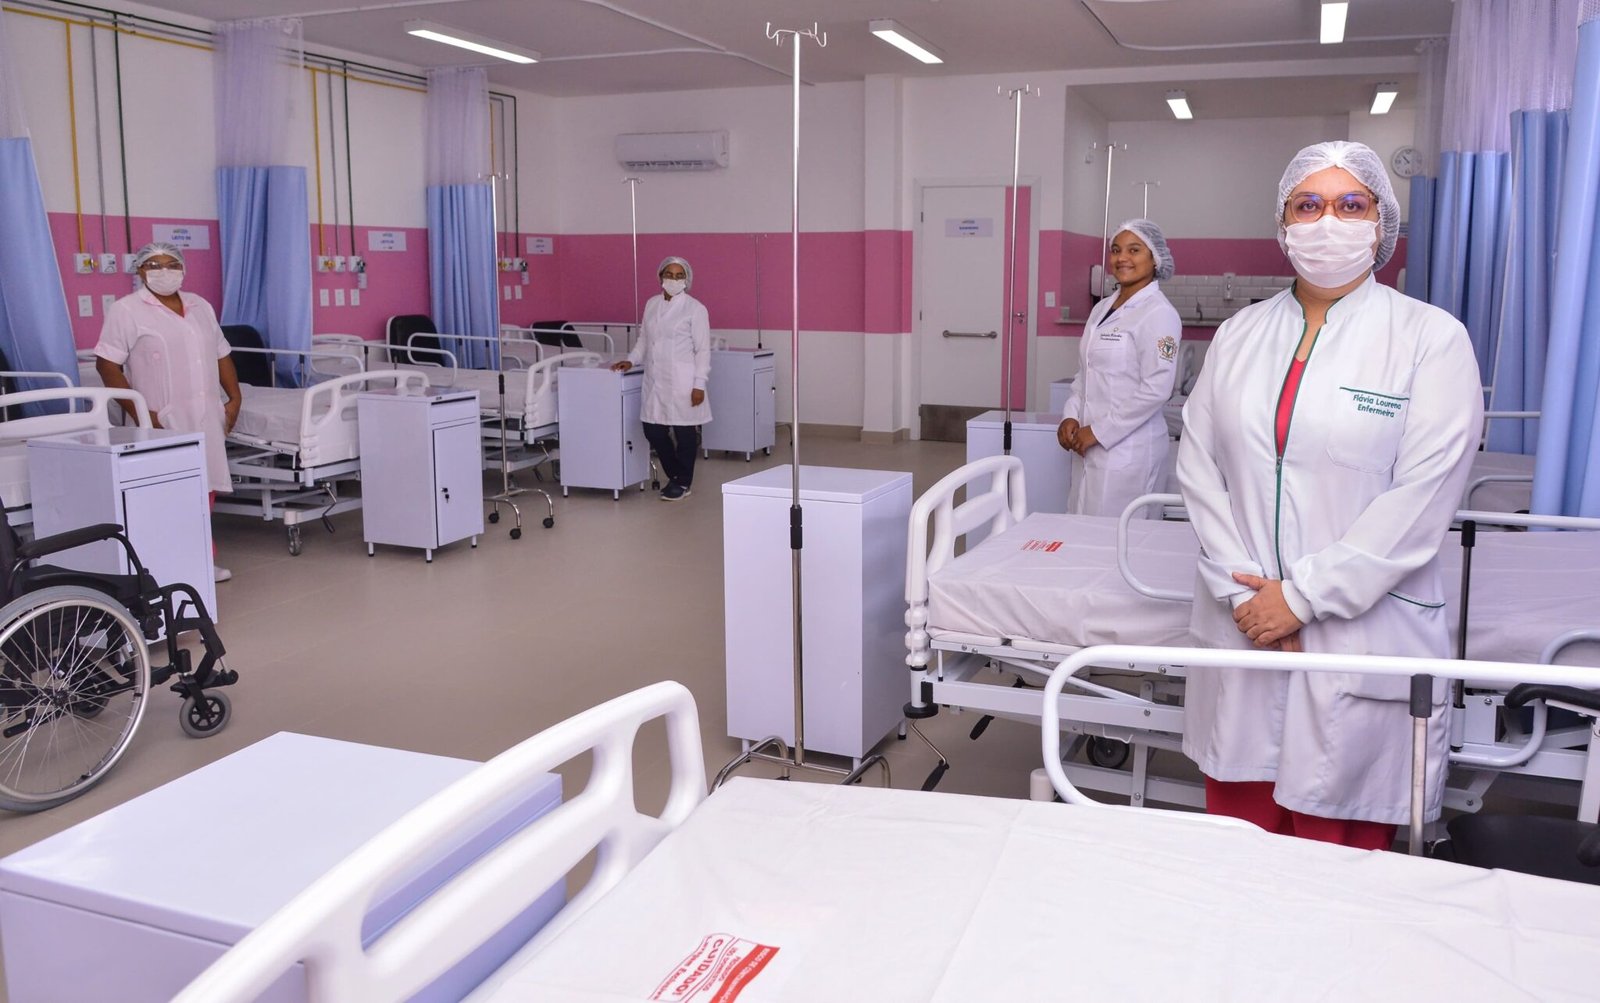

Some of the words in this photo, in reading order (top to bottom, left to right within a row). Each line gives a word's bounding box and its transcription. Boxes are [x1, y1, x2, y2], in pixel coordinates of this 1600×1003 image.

[1353, 394, 1374, 404] Flávia
[1357, 403, 1395, 418] Enfermeira
[672, 938, 724, 996] CUIDADO!
